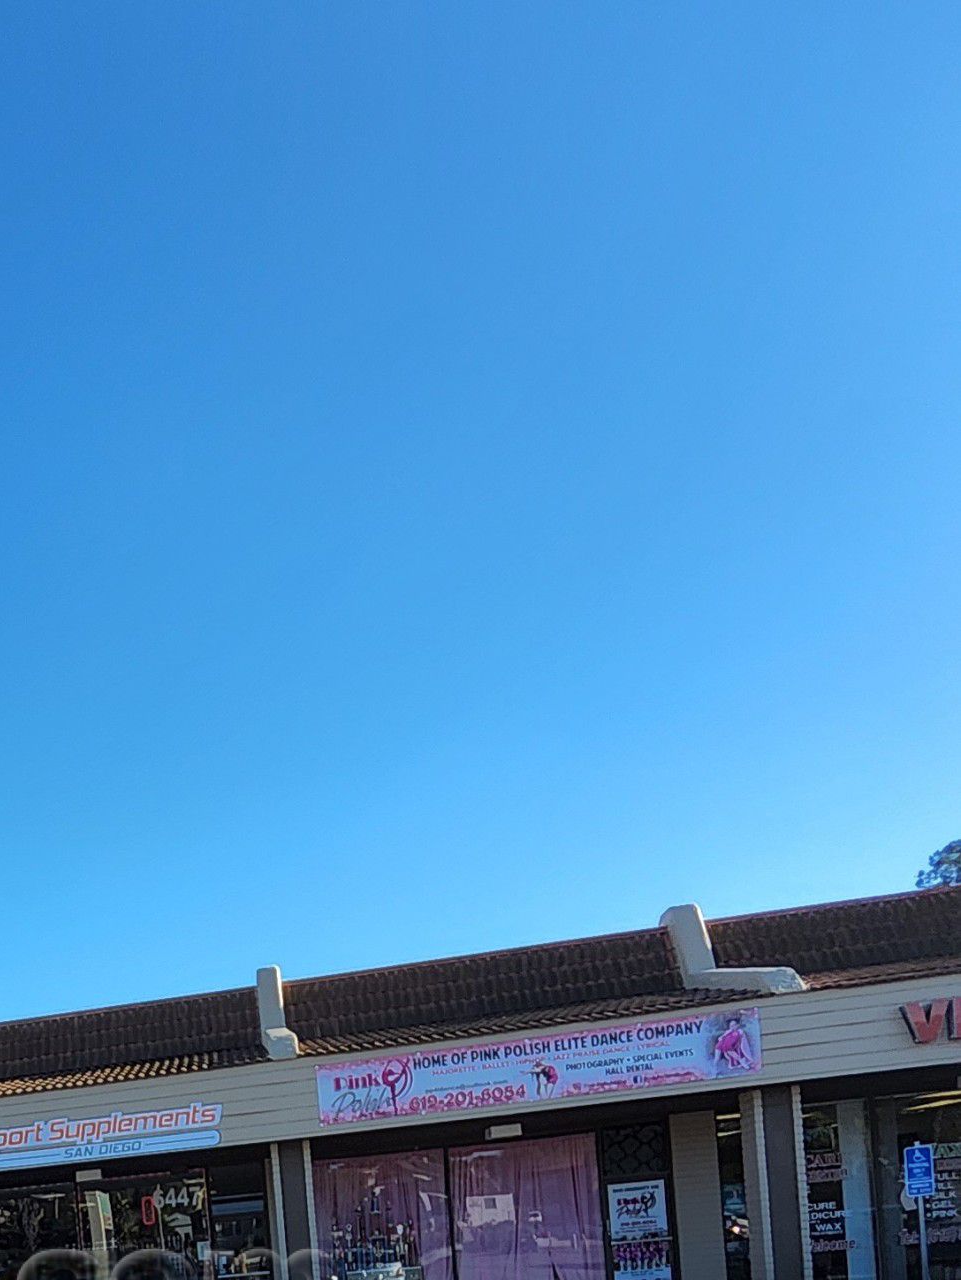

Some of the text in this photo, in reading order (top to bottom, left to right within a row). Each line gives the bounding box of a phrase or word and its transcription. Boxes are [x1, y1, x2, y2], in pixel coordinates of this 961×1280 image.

[412, 1020, 704, 1071] HOME OF PINK POLISH ELITE DANCE COMPANY
[565, 1049, 694, 1071] PHOTOGRAPHY SPECIAL EVENTS
[605, 1063, 654, 1077] HALL RENTAL
[47, 1102, 220, 1143] Supplements
[63, 1141, 142, 1160] SAN DIEGO
[153, 1187, 201, 1208] 6447
